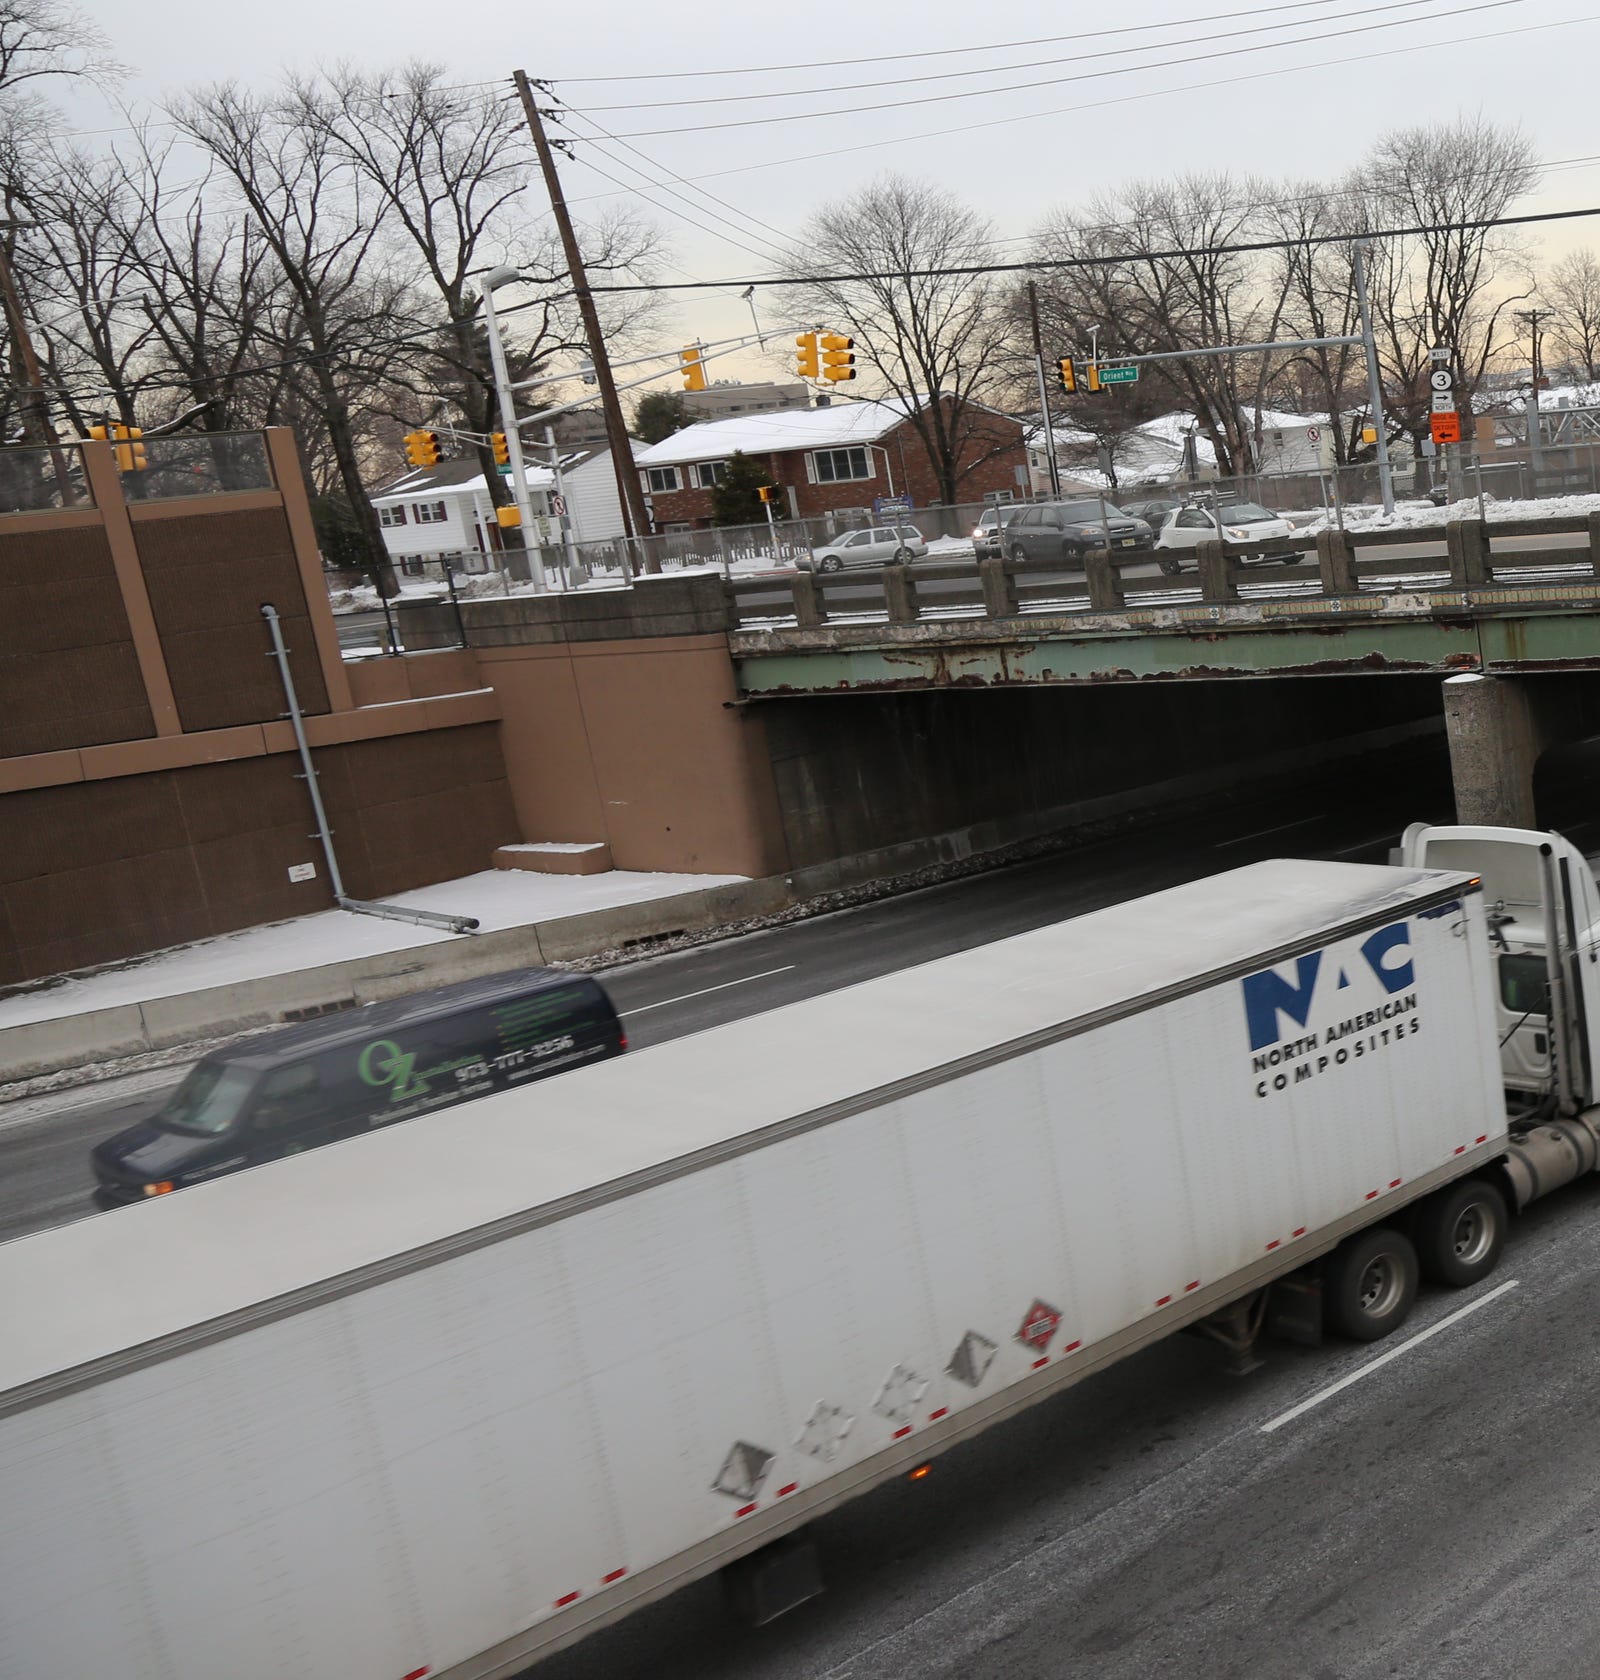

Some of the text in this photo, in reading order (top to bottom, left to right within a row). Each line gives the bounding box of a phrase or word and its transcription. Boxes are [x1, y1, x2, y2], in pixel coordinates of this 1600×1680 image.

[1103, 371, 1124, 380] Orient
[1436, 374, 1447, 387] 3
[1241, 921, 1415, 1052] NAC
[1253, 993, 1418, 1074] NORTH AMERICAN
[1256, 1017, 1420, 1098] COMPOSITES
